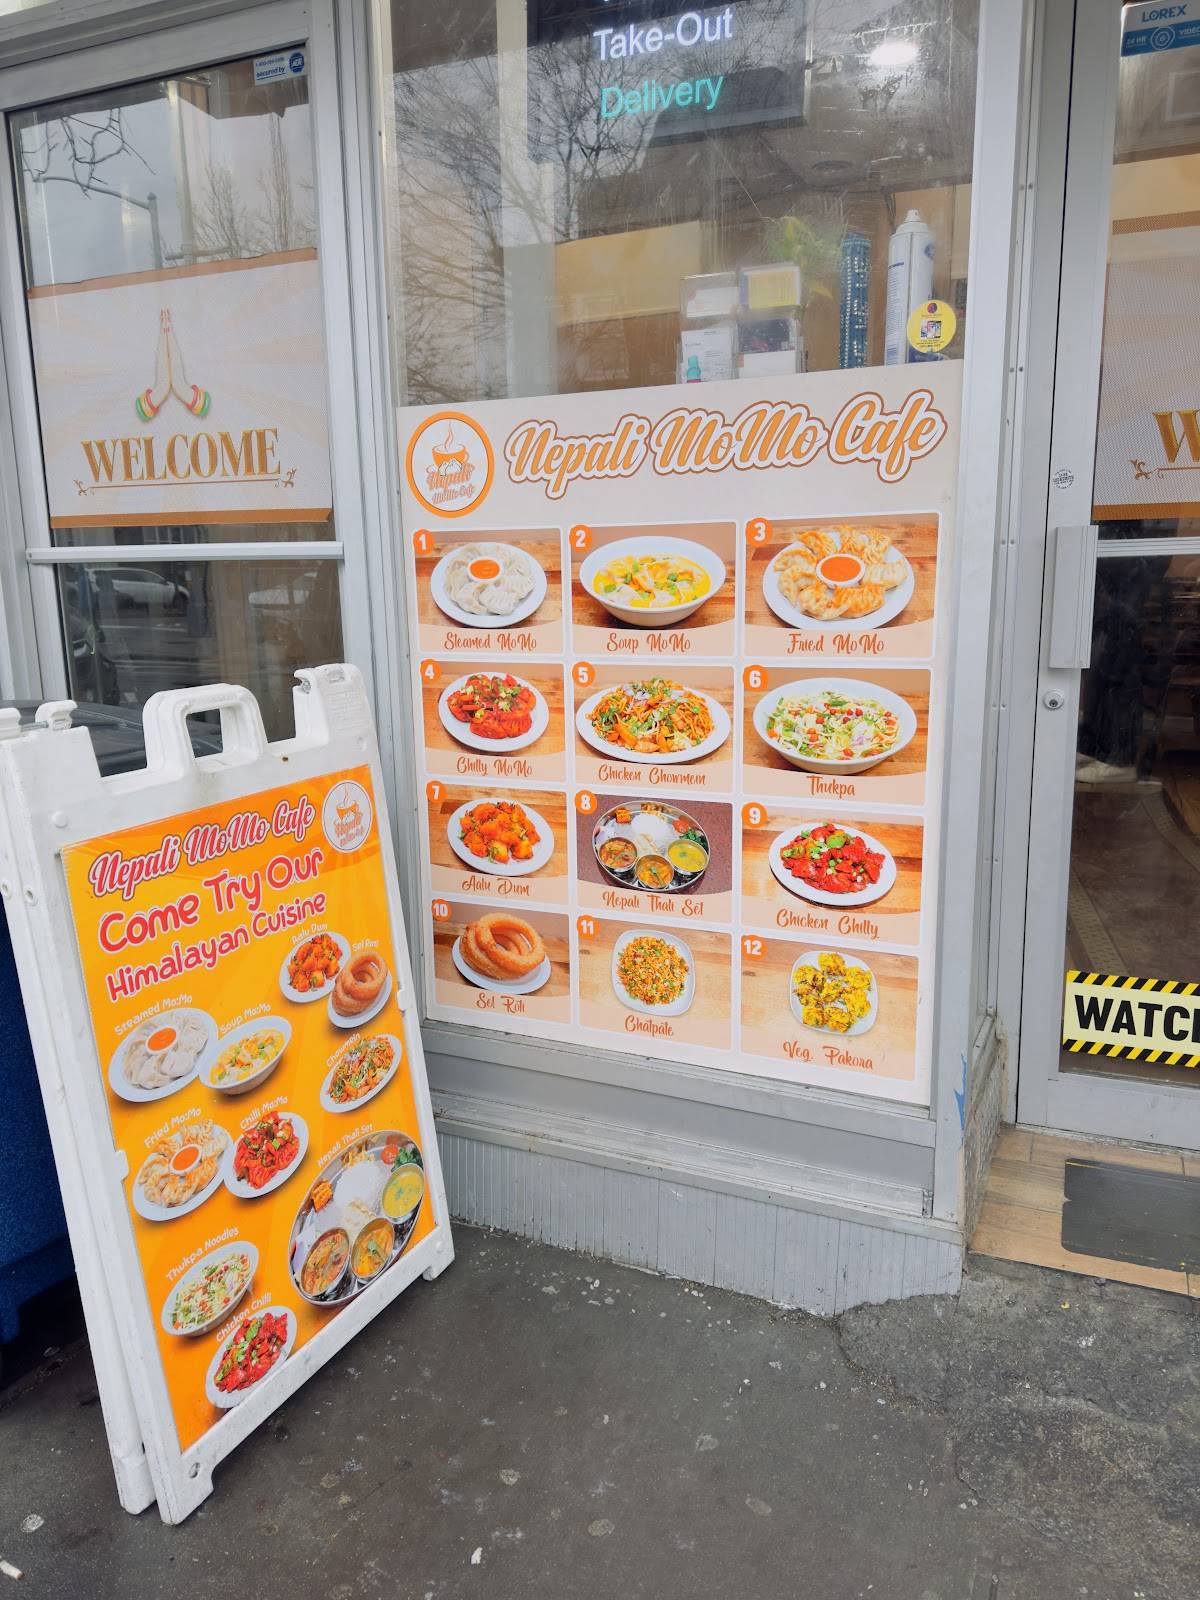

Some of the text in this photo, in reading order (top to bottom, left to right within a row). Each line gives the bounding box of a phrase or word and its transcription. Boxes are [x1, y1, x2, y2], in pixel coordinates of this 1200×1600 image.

[1142, 4, 1187, 22] LOREX
[593, 7, 734, 60] Take-Out
[600, 75, 725, 119] Delivery
[506, 390, 946, 499] Nepali MoMo Cafe
[81, 428, 281, 483] WELCOME
[419, 535, 427, 550] 1
[575, 530, 586, 547] 2
[753, 522, 766, 542] 3
[444, 631, 537, 652] Steamed MoMo
[607, 632, 691, 654] Soup MoMo
[787, 633, 884, 654] Fried MoMo
[424, 664, 435, 680] 4
[578, 666, 589, 683] 5
[749, 670, 762, 688] 6
[456, 756, 533, 777] Chilly MoMo
[598, 764, 706, 786] Chicken Chowmein
[431, 785, 440, 800] 7
[806, 775, 855, 798] Thukpa
[580, 794, 591, 810] 8
[749, 807, 761, 824] 9
[89, 796, 315, 901] Nepali MoMo Cafe
[461, 875, 530, 896] Aalu Dum
[99, 848, 325, 953] Come Try Our
[433, 903, 449, 917] 10
[602, 891, 704, 917] Nepali Thali Set
[581, 920, 594, 935] 11
[776, 908, 880, 940] Chicken Chilly
[106, 892, 327, 1003] Himalayan Cuisine
[743, 939, 763, 956] 12
[476, 992, 525, 1014] Sel Roti
[114, 1002, 161, 1036] Steamed
[220, 1014, 243, 1034] Soup
[624, 1014, 674, 1037] Chatpate
[783, 1040, 874, 1069] Veg. Pakora
[240, 1109, 261, 1130] Chilli
[144, 1122, 171, 1149] Fried
[166, 1226, 240, 1281] Thukpa Noodles
[216, 1291, 273, 1342] Chicken Chilli
